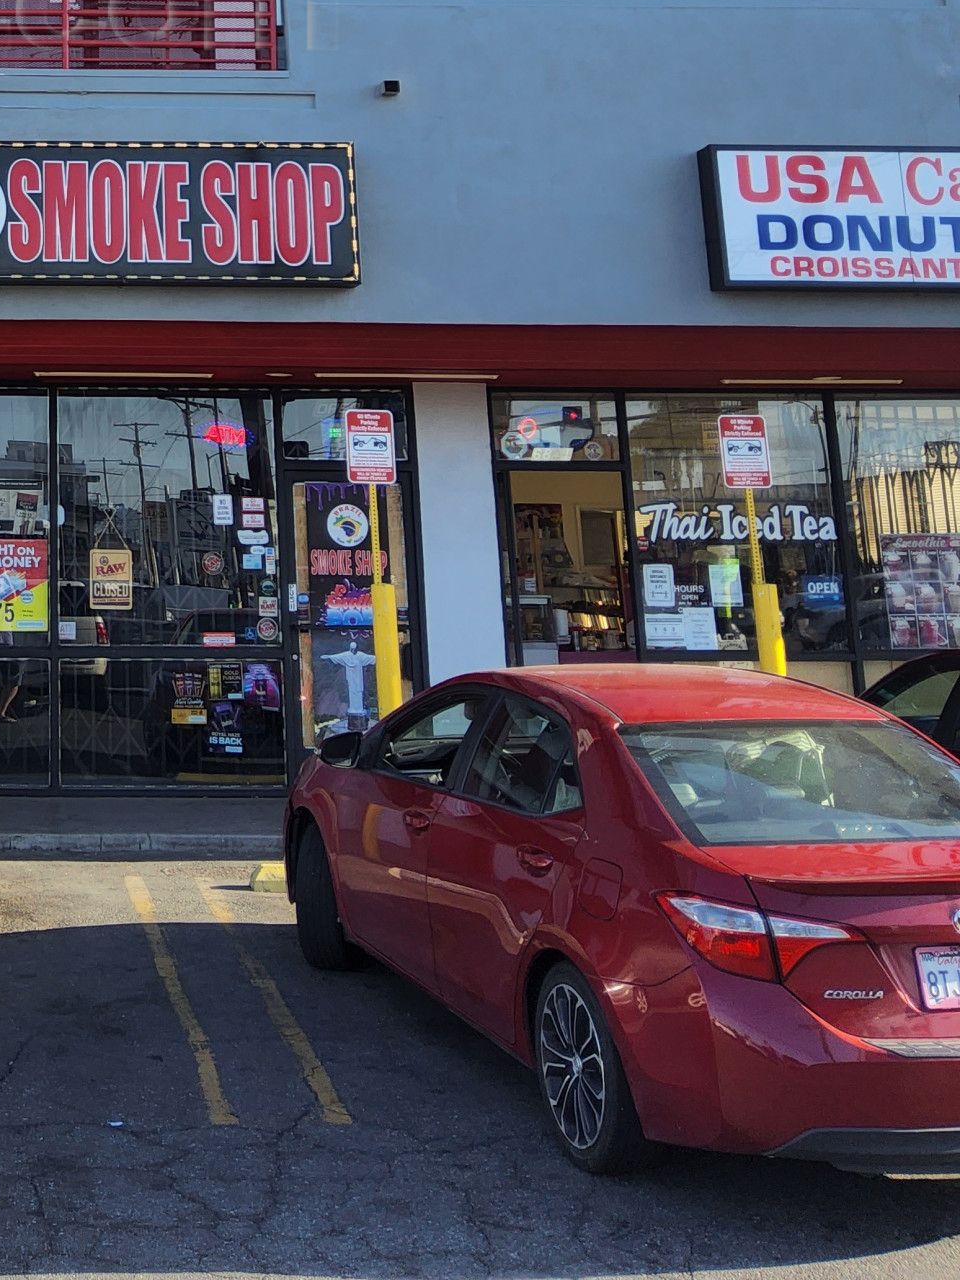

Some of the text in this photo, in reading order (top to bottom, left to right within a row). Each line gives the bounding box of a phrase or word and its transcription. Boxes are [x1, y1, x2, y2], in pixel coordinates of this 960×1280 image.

[735, 154, 960, 206] USA C
[7, 158, 346, 266] SMOKE SHOP
[202, 424, 246, 447] ATM
[333, 505, 362, 516] BRAZIL
[639, 502, 838, 543] Thai Iced Tea
[895, 537, 946, 548] Smoothie
[16, 546, 35, 556] ON
[95, 562, 127, 576] RAW
[310, 548, 388, 577] SMOKE SHP
[93, 582, 130, 597] CLOSED
[673, 584, 705, 593] HOURS
[807, 581, 840, 594] OPEN
[260, 602, 277, 610] RAW
[209, 737, 243, 745] IS BACK
[823, 988, 884, 1000] COROLLA
